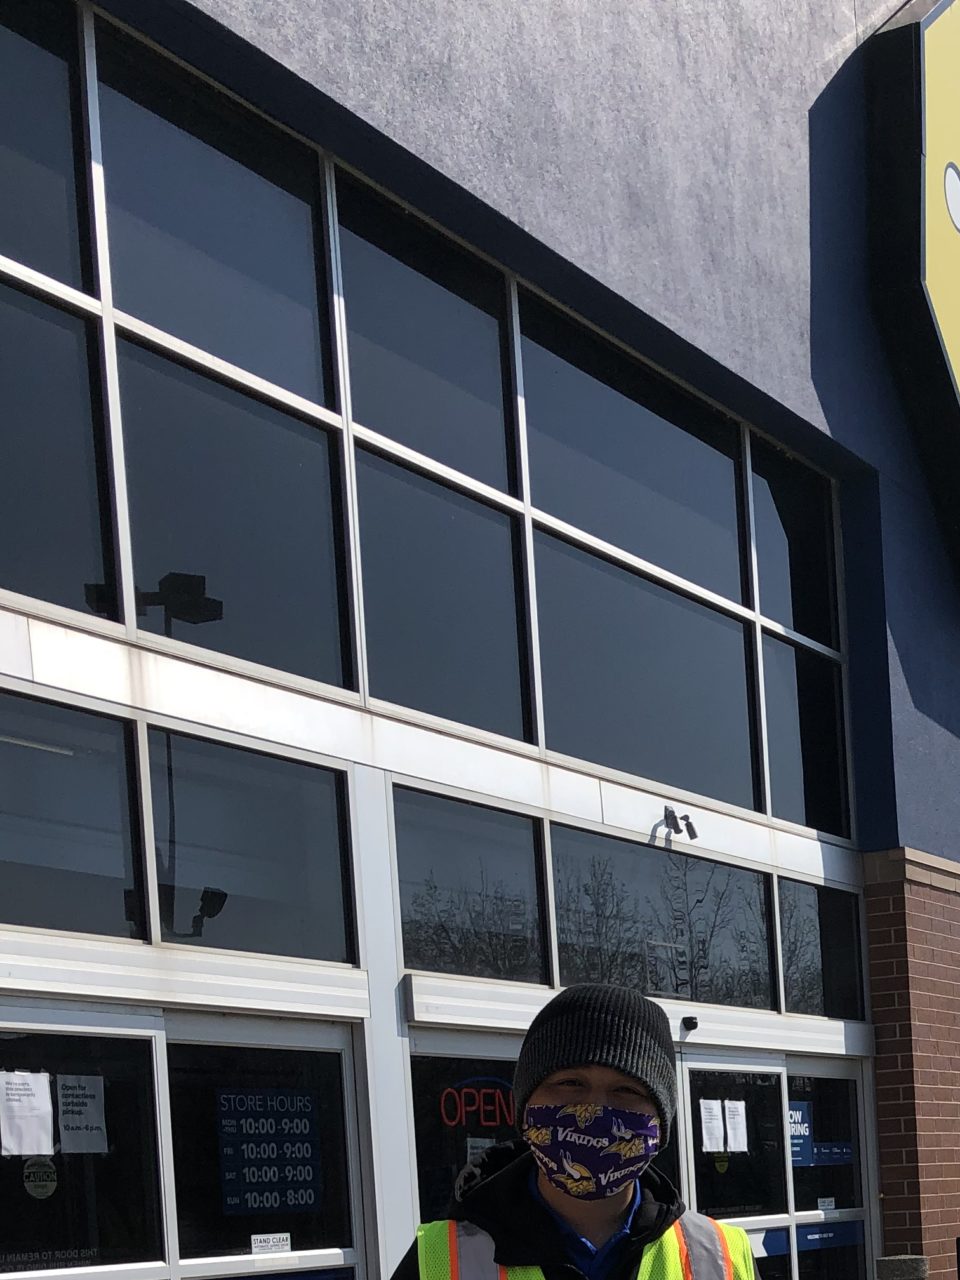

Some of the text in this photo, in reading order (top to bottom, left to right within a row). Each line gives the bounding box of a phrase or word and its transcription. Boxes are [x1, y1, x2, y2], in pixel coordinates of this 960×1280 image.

[61, 1083, 87, 1092] Open for
[62, 1092, 96, 1100] contactless
[62, 1100, 88, 1108] curbside
[220, 1094, 312, 1112] STORE HOURS
[440, 1087, 514, 1127] OPEN
[221, 1119, 236, 1127] MON
[23, 1171, 57, 1182] CAUTION
[226, 1197, 240, 1205] SUN
[253, 1236, 288, 1245] STAND CLEAR
